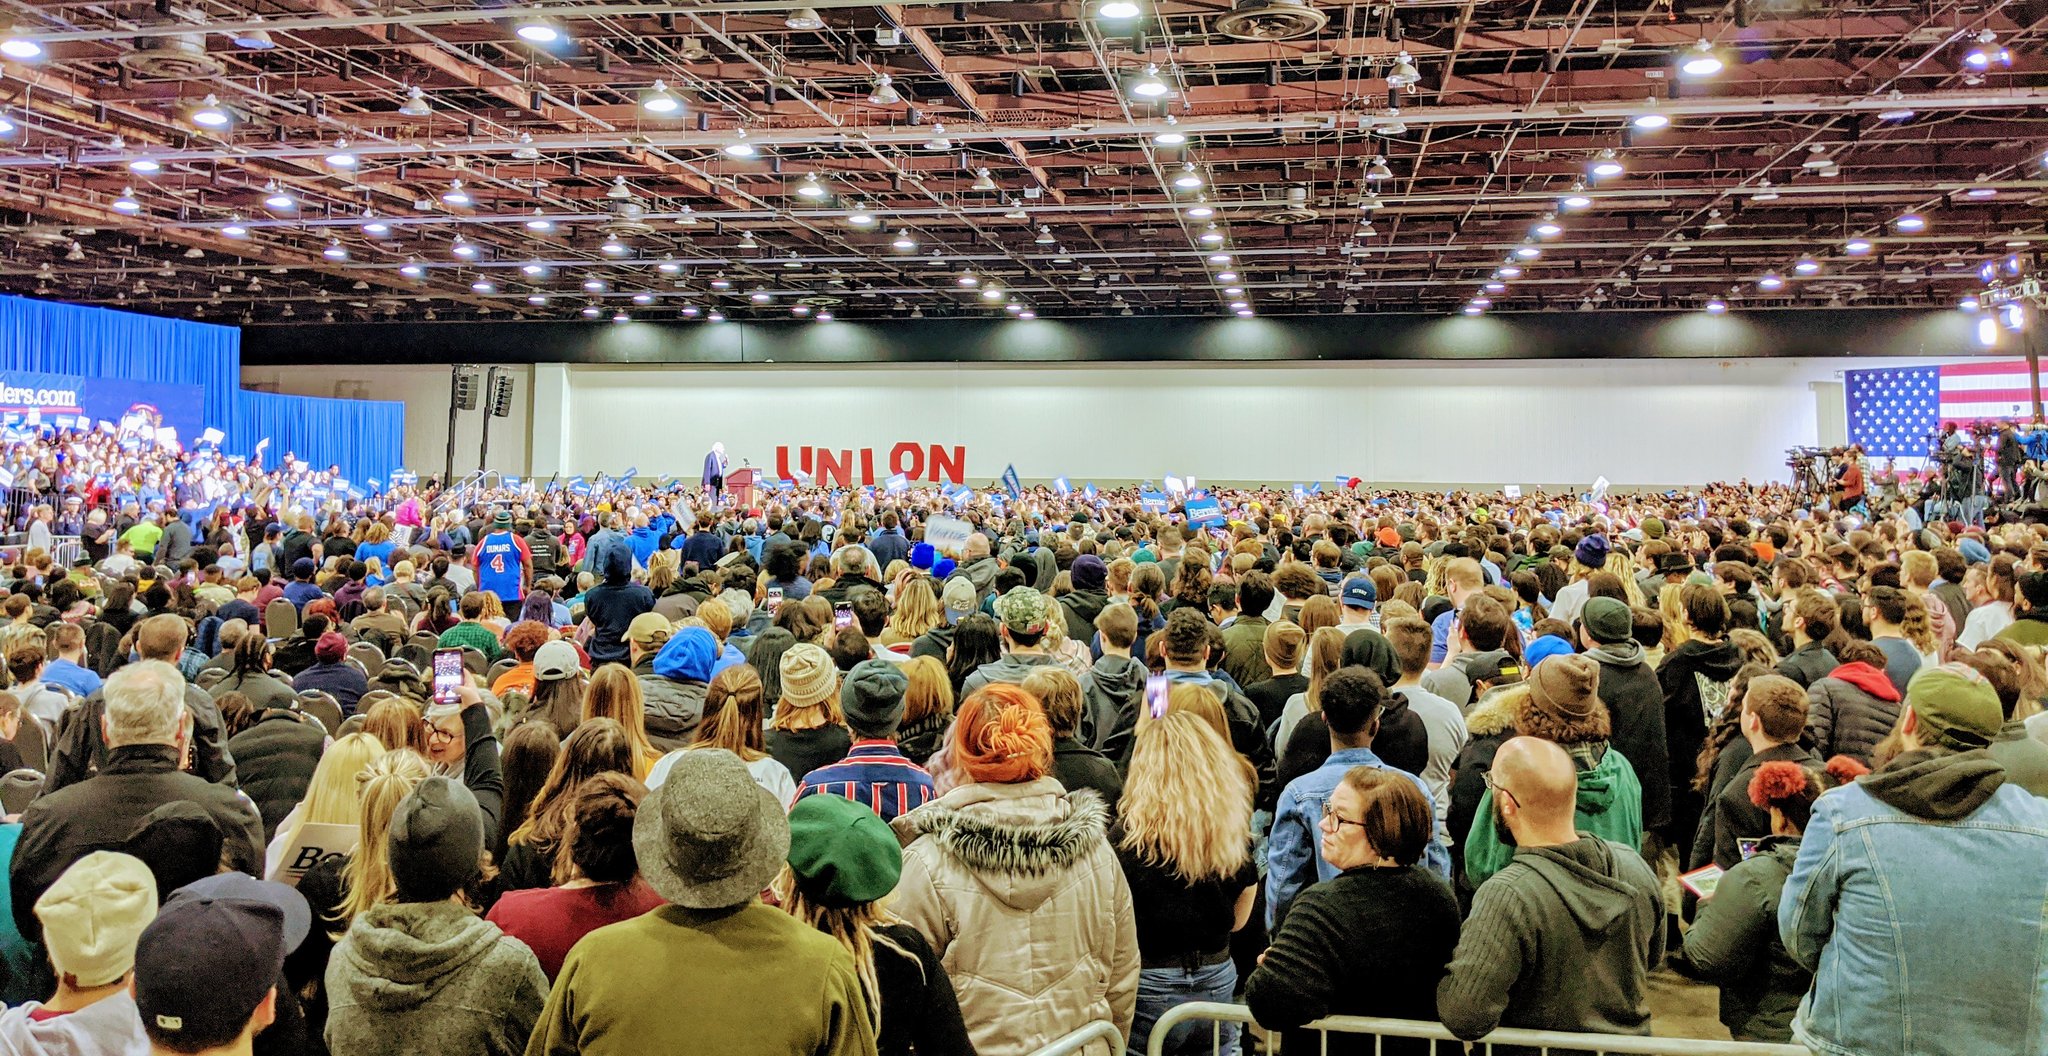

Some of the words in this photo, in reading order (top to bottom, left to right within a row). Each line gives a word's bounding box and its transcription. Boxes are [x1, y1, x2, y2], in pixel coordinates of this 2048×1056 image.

[776, 442, 965, 486] UNION
[1189, 506, 1219, 519] Bernie
[486, 544, 511, 553] DUMARS
[490, 554, 505, 573] 4
